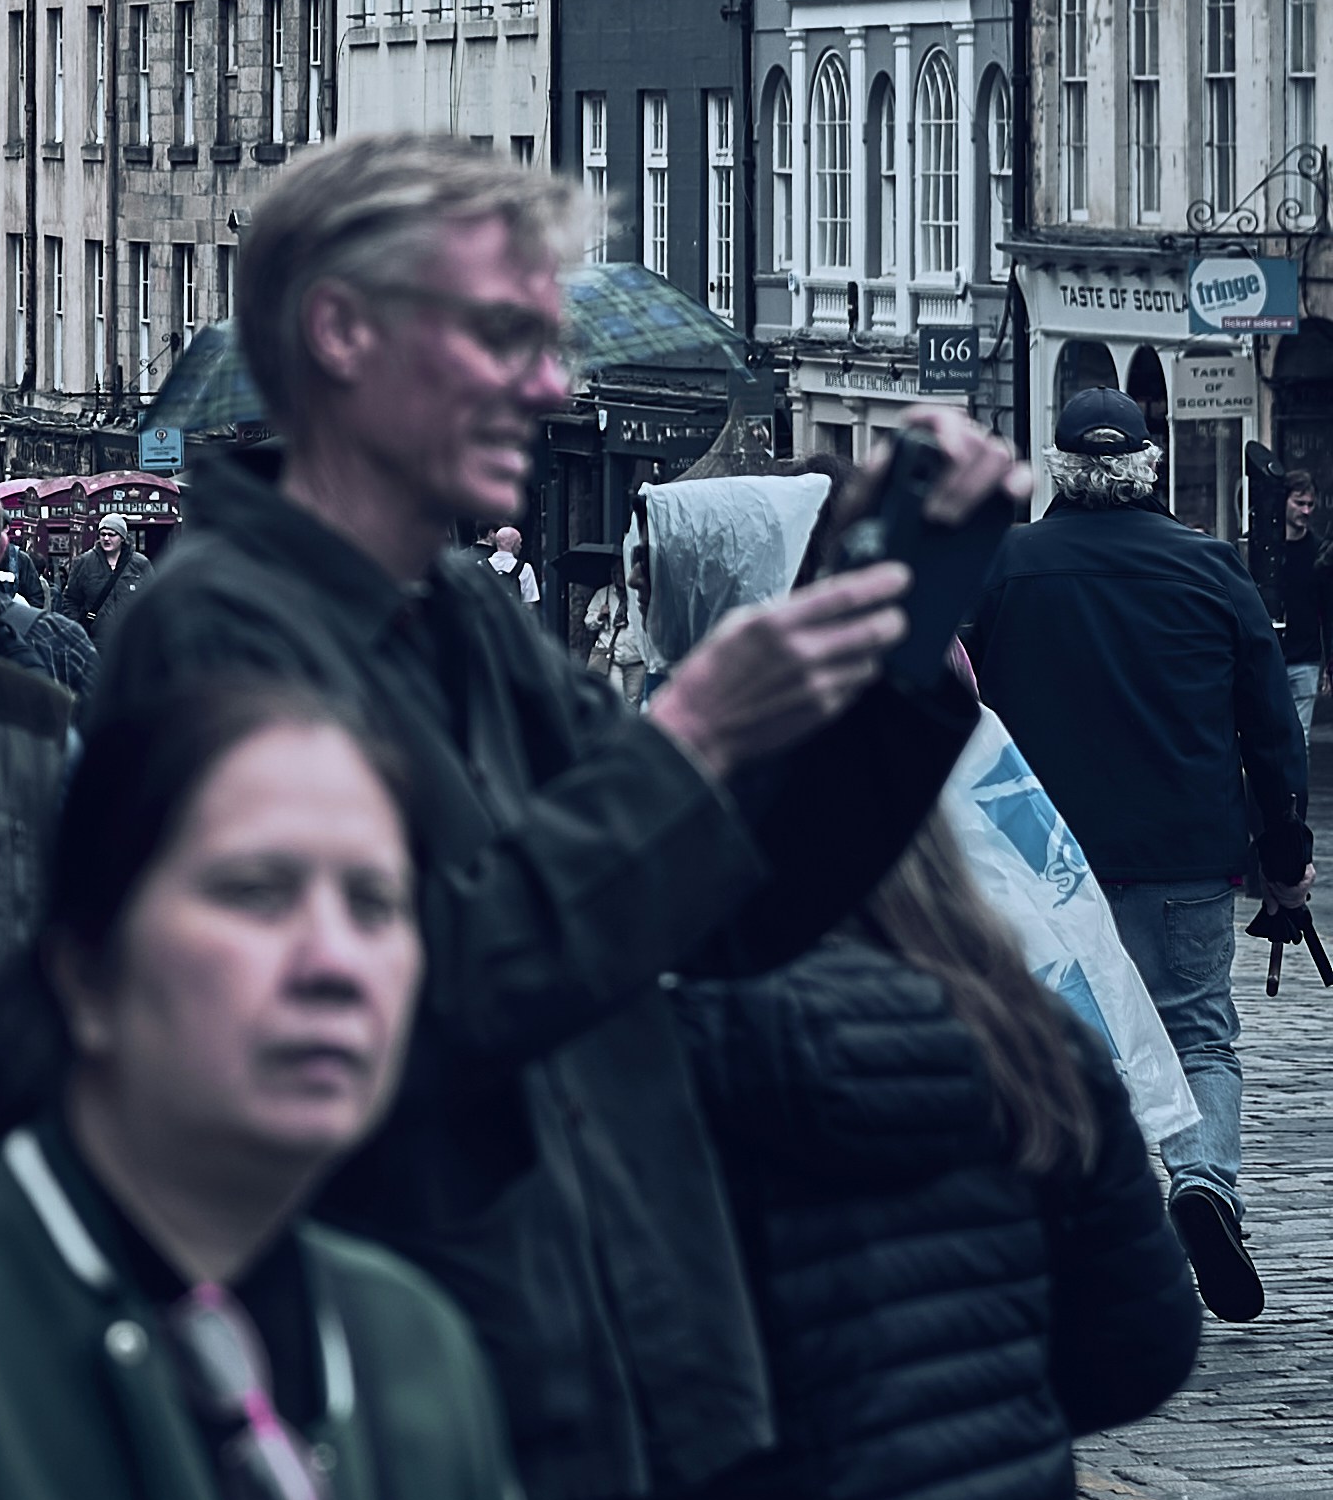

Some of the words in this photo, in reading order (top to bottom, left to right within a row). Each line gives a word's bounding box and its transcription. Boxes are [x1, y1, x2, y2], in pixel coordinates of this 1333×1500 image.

[1060, 285, 1105, 308] TASTE
[1110, 288, 1128, 310] OF
[1195, 274, 1260, 306] fringe
[929, 337, 971, 362] 166
[925, 369, 946, 380] High
[948, 369, 973, 379] Street
[99, 502, 169, 513] TELEPHONE
